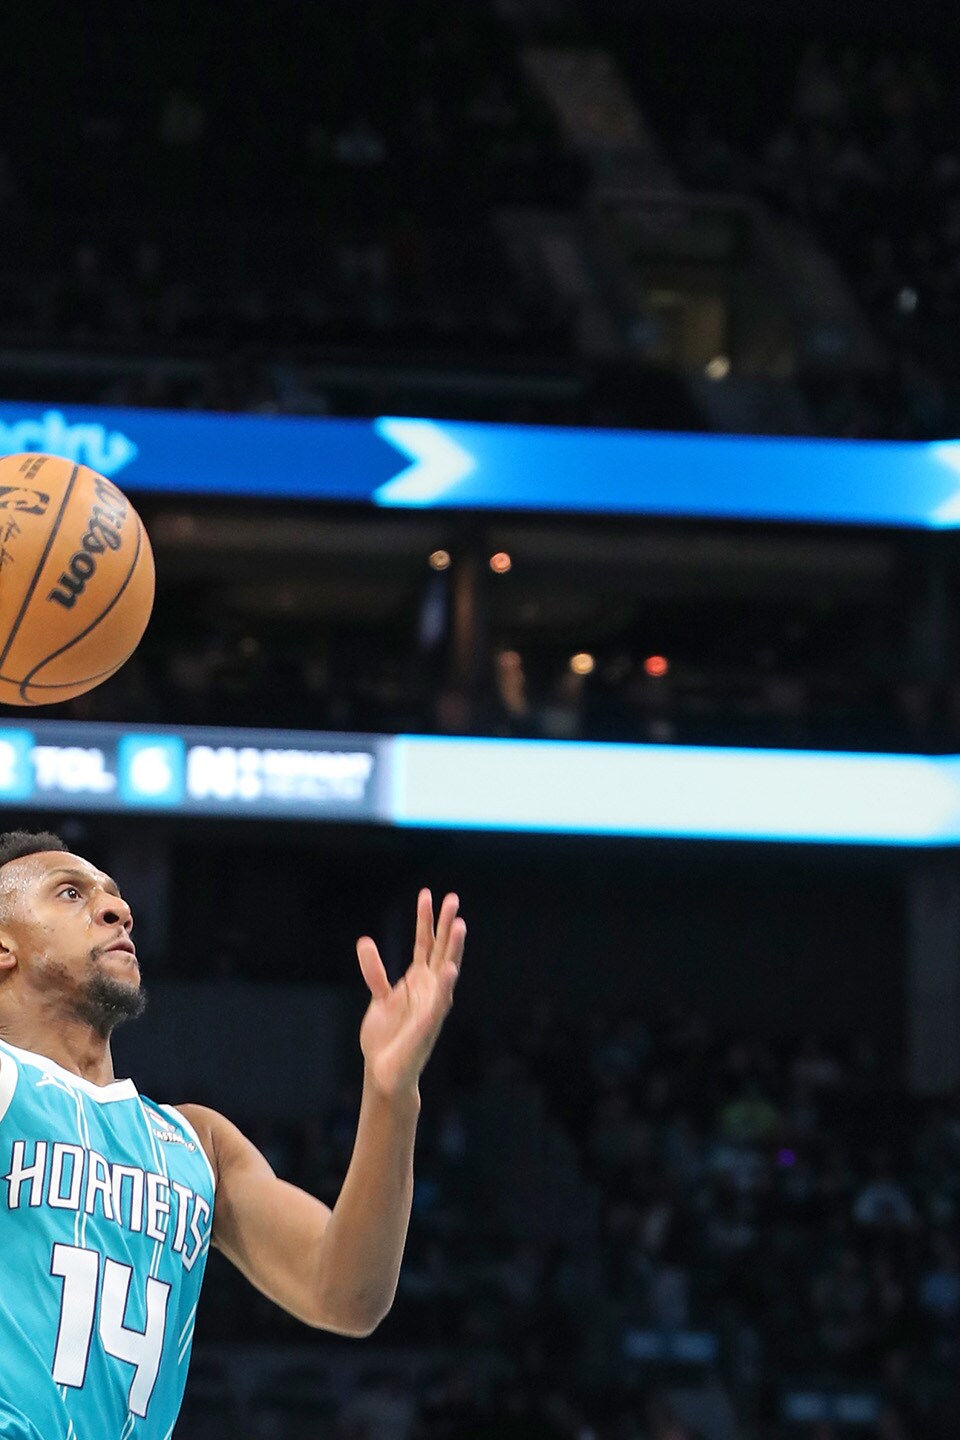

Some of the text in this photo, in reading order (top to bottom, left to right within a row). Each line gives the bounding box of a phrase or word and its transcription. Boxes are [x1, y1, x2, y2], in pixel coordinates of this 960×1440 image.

[47, 476, 128, 610] Wilson
[0, 1140, 211, 1272] HORNETS
[50, 1241, 172, 1420] 14
